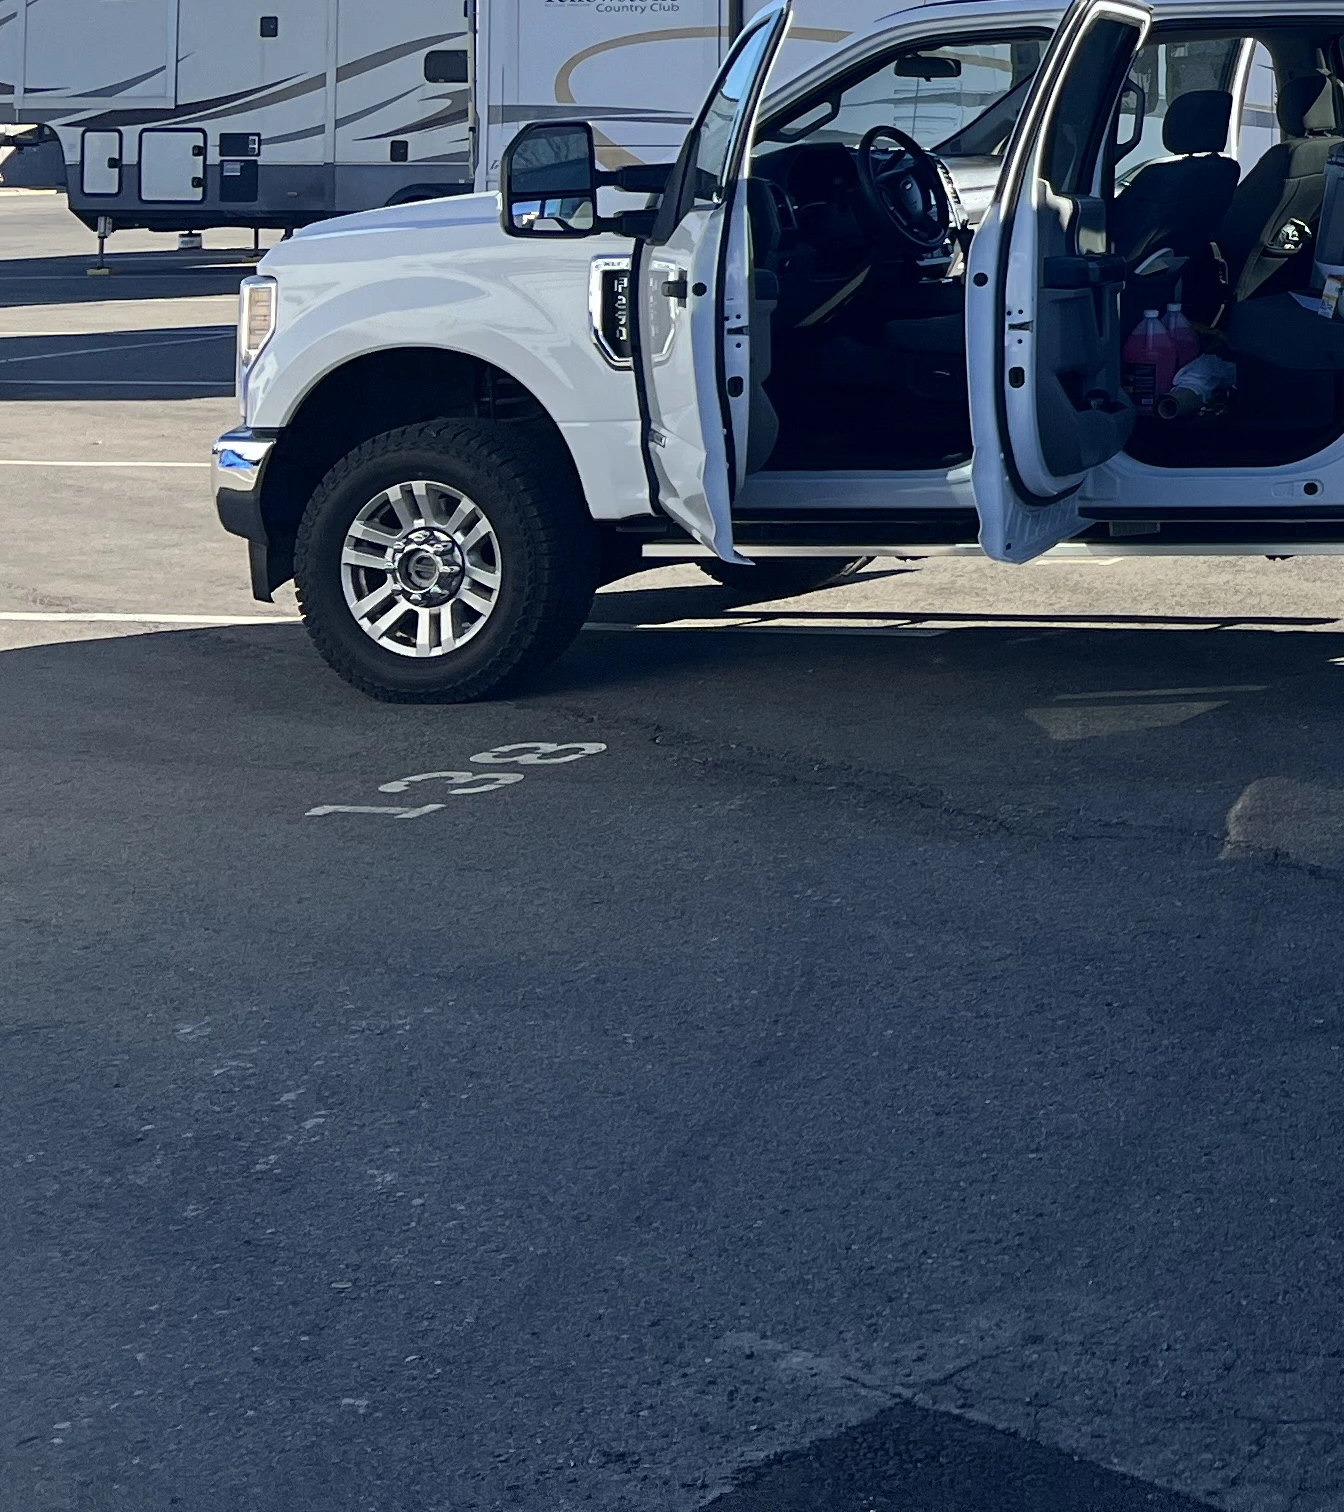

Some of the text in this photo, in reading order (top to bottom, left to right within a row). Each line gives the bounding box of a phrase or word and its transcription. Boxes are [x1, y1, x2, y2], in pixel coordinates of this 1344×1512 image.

[595, 3, 647, 14] Country
[649, 2, 680, 13] Club
[304, 741, 608, 819] 138
